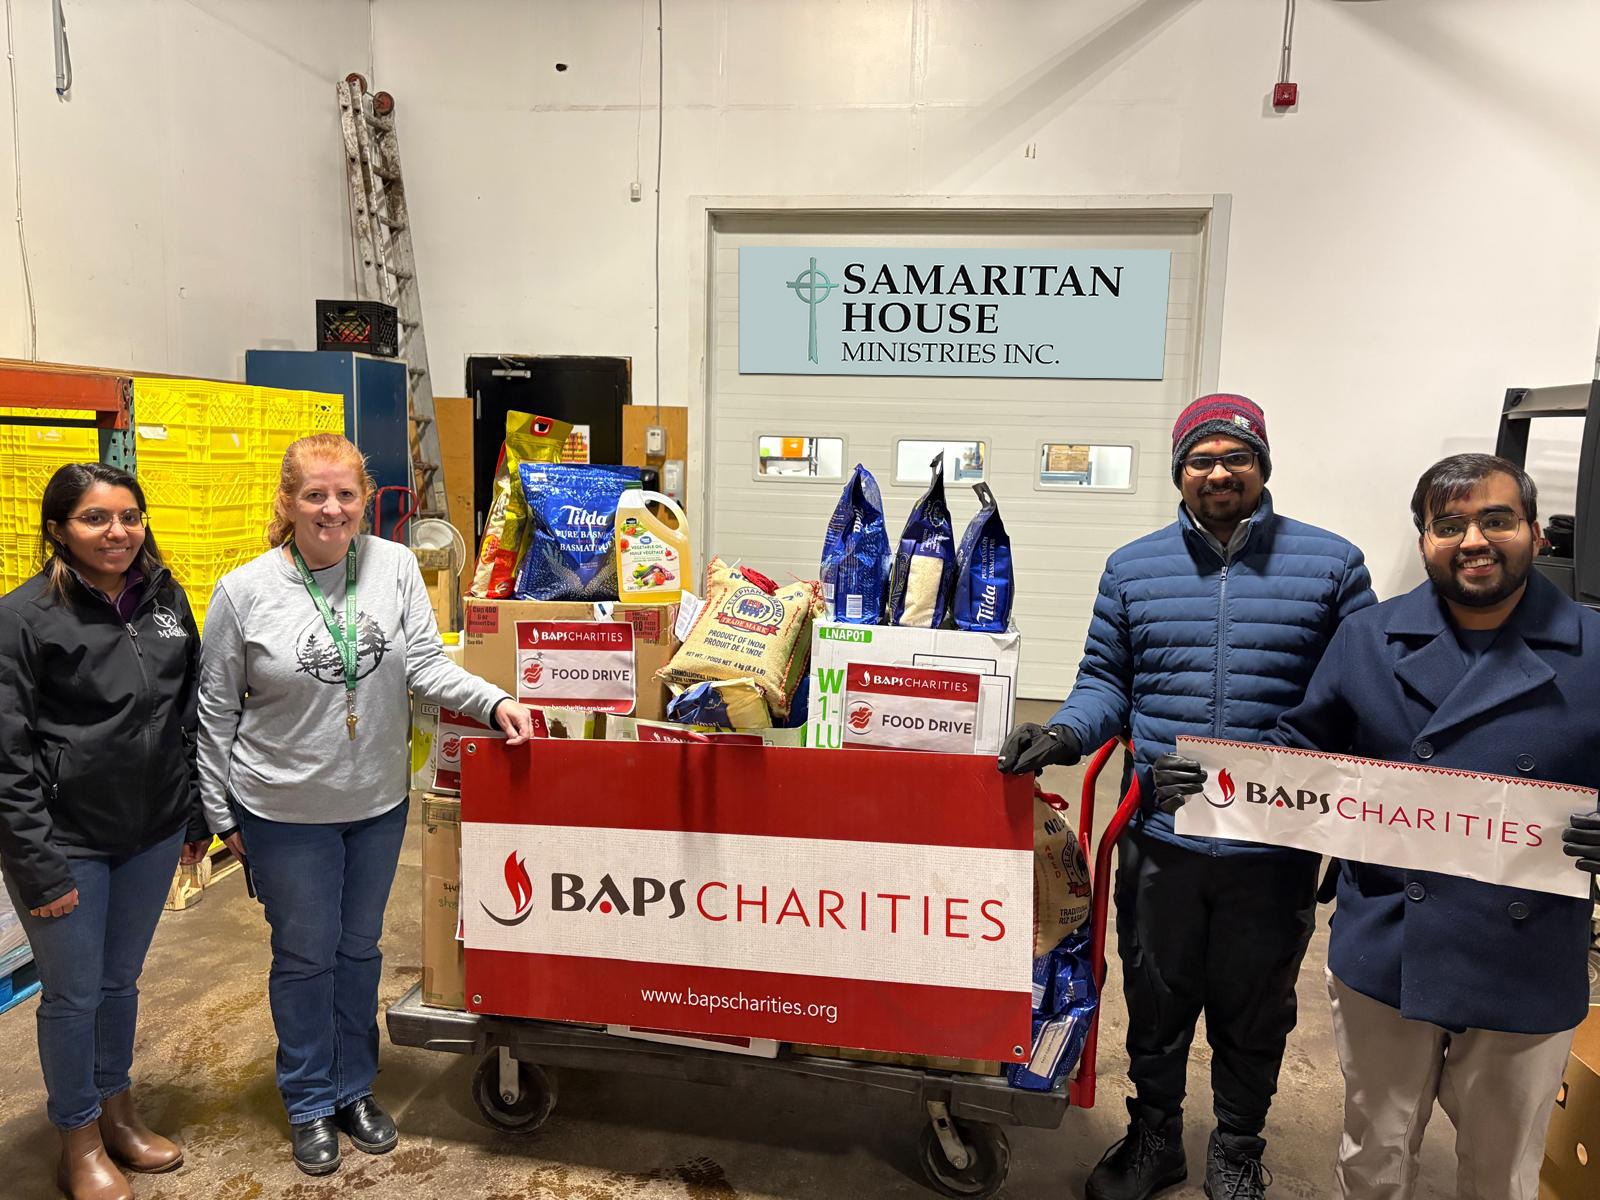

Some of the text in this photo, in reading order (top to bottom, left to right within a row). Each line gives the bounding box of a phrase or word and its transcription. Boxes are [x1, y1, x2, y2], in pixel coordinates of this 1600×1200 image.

[843, 263, 1124, 297] SAMARITAN
[841, 303, 999, 334] HOUSE
[841, 342, 1060, 365] MINISTRIES INC.
[559, 505, 608, 526] Tilda
[977, 585, 996, 624] Tilda
[722, 618, 769, 634] TRADE MARK
[825, 628, 866, 642] LNAP01
[703, 637, 764, 657] PRODUIT DE L'INDE
[708, 630, 766, 650] PRODUCT OF INDIA
[722, 659, 732, 667] NET
[551, 669, 630, 681] FOOD DRIVE
[882, 714, 973, 735] FOOD DRIVE
[1336, 796, 1543, 848] CHARITIES
[697, 881, 1006, 942] CHARITIES
[640, 987, 838, 1024] www.bapscharities.org
